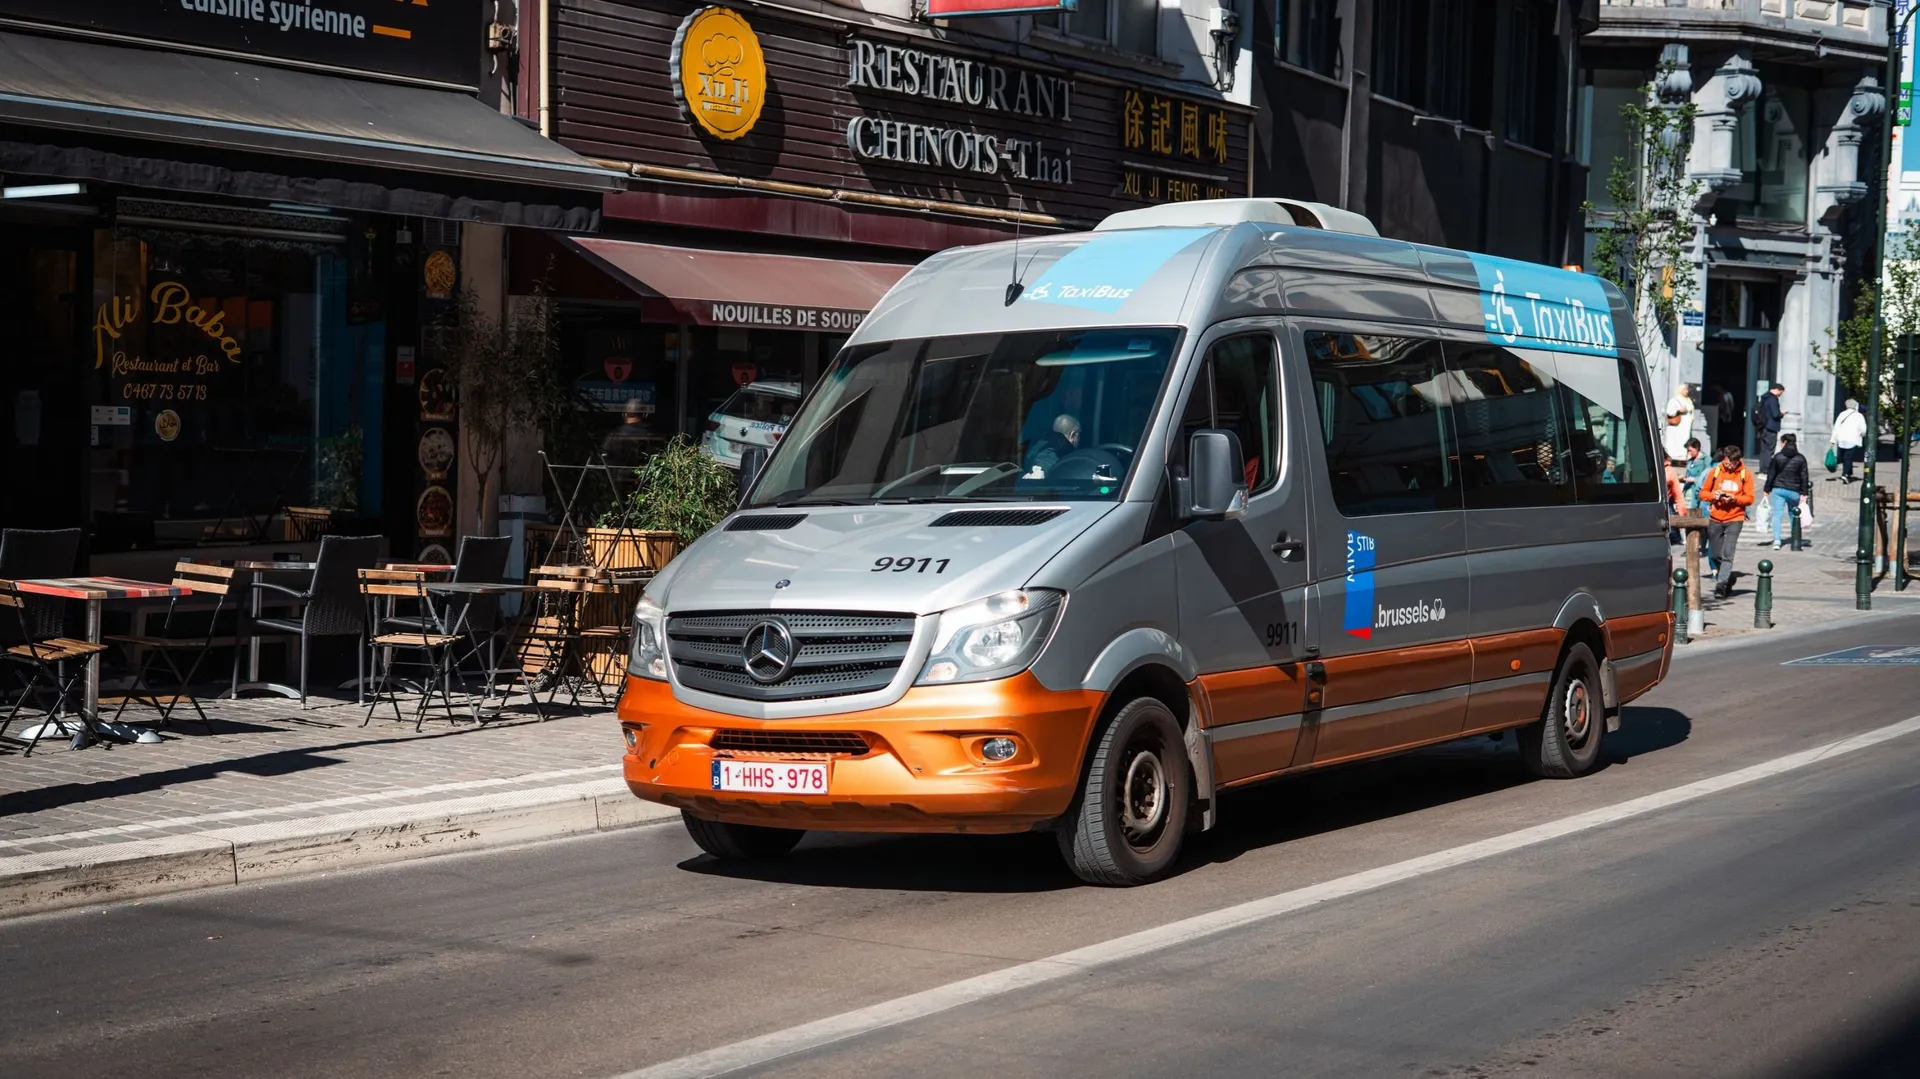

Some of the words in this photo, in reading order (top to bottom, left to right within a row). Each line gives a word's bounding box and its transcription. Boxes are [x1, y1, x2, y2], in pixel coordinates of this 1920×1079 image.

[270, 0, 366, 38] syrienne
[698, 72, 725, 98] Xu
[730, 78, 749, 103] Ji
[848, 40, 1075, 122] RESTAURANT
[1124, 90, 1228, 163] 徐記風味
[848, 116, 1073, 184] CHINOIS-Thai
[1124, 172, 1140, 195] XU
[1149, 177, 1159, 198] JI
[1168, 180, 1198, 201] FENG
[1057, 285, 1133, 299] TaxiBus
[93, 296, 140, 369] Ali
[151, 281, 241, 364] Baba
[712, 304, 792, 325] NOUILLES
[797, 309, 817, 327] DE
[1525, 291, 1614, 351] TaxiBus
[112, 351, 178, 378] Restaurant
[181, 357, 192, 375] et
[195, 354, 220, 375] Bar
[123, 384, 156, 399] 0467
[159, 384, 173, 399] 73
[870, 556, 951, 574] 9911
[1375, 599, 1429, 628] .brussels
[1267, 621, 1297, 647] 9911
